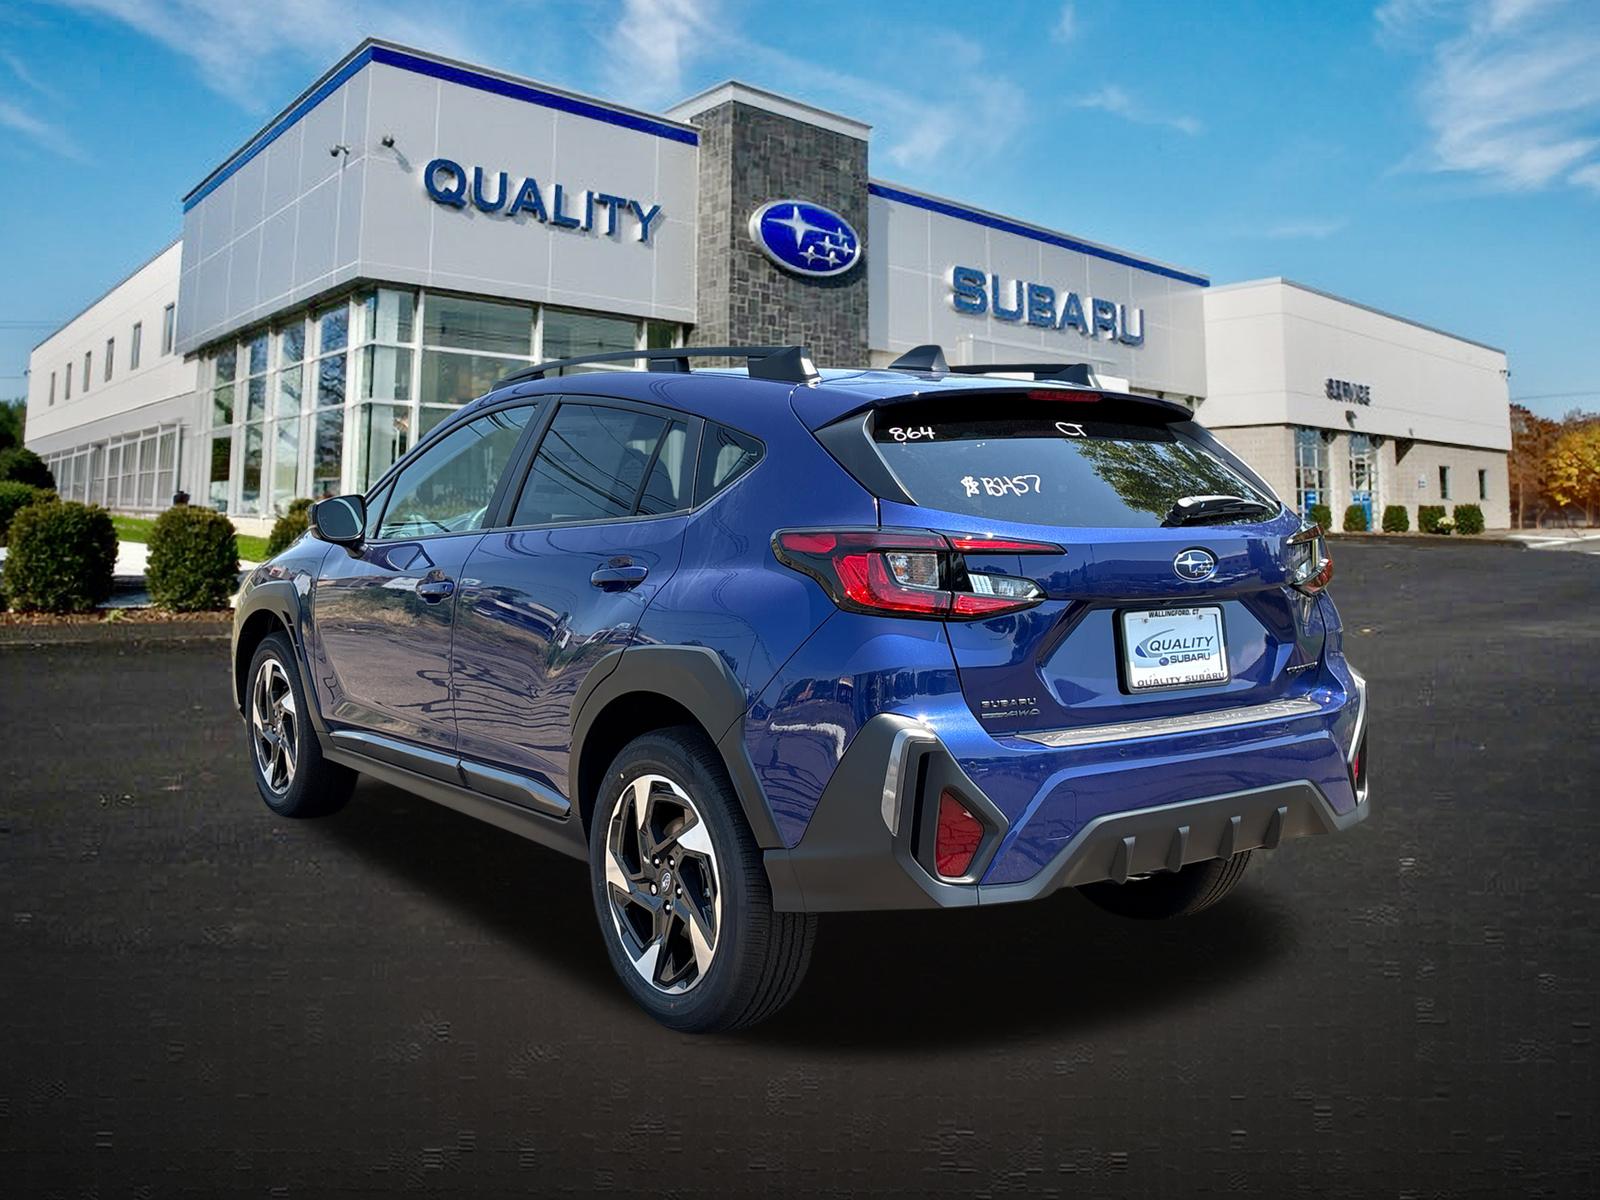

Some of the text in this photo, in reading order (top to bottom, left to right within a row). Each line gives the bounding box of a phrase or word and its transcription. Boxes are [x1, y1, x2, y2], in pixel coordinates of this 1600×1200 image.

[424, 158, 661, 243] QUALITY
[953, 265, 1144, 346] SUBARU
[889, 426, 936, 441] 864
[1192, 608, 1199, 616] CT
[1149, 636, 1214, 652] QUALITY
[1169, 652, 1211, 664] SUBARU
[1137, 672, 1225, 688] QUALITY SUBARU
[981, 697, 1037, 709] SUBARU
